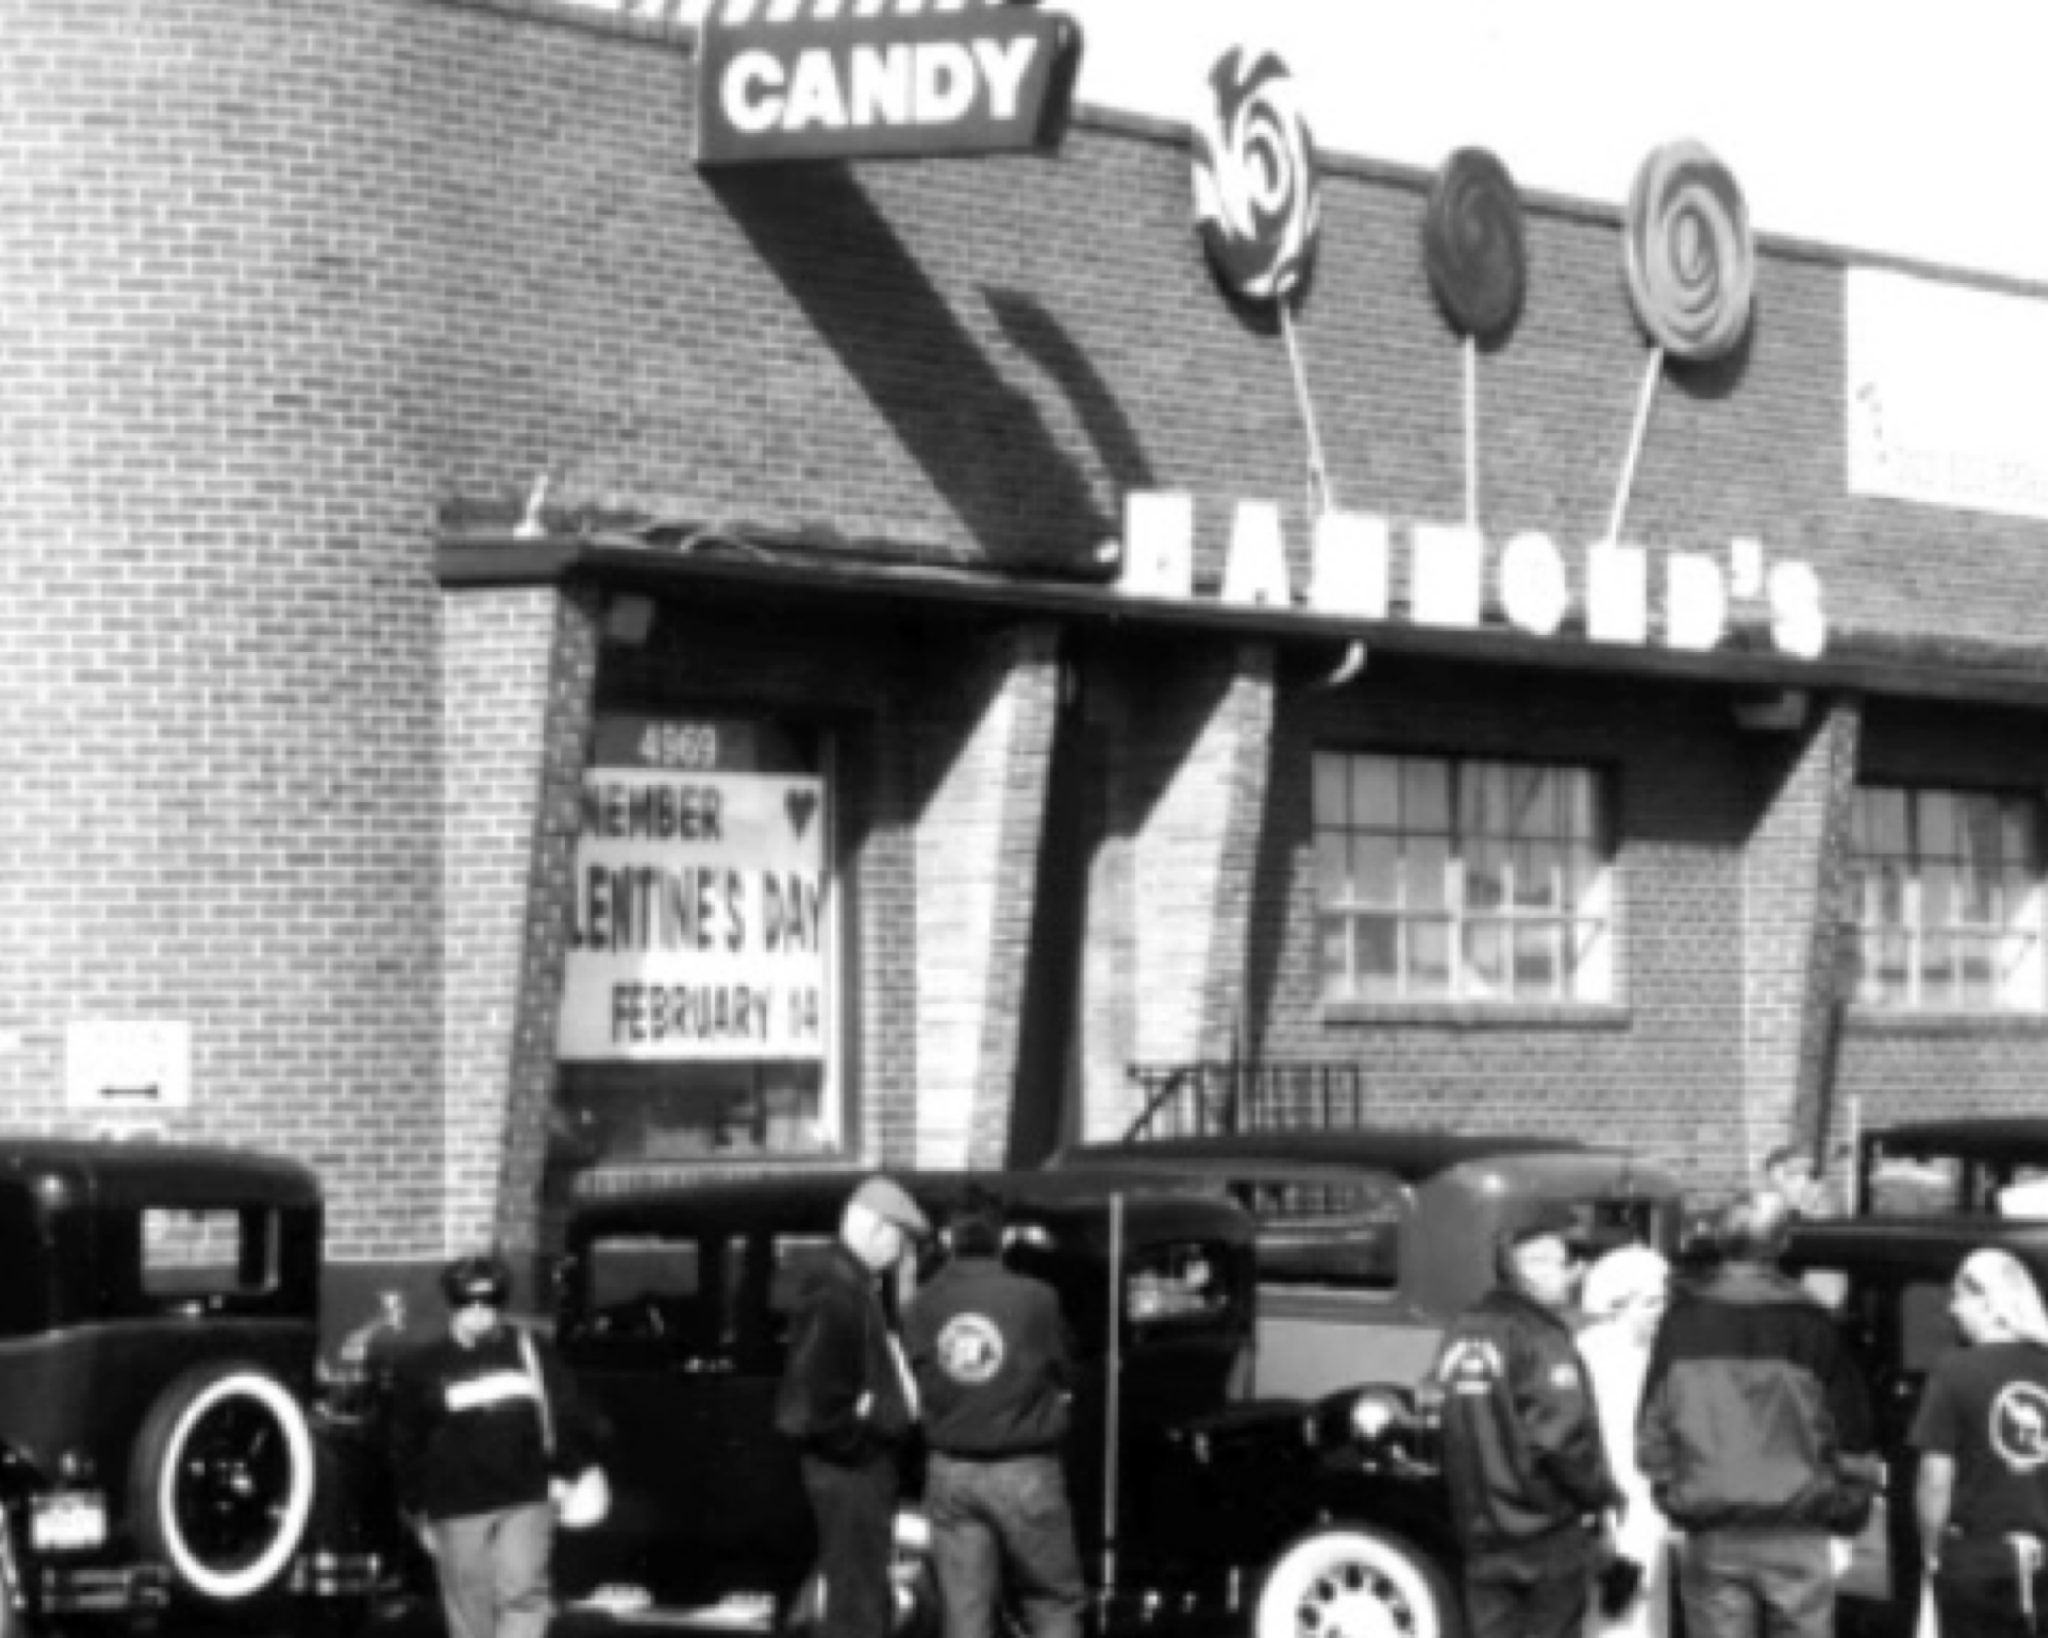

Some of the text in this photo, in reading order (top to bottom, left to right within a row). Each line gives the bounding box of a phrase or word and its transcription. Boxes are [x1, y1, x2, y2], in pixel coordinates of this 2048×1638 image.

[719, 36, 1038, 135] CANDY
[762, 867, 829, 953] DAY
[612, 981, 770, 1042] FEBRUARY
